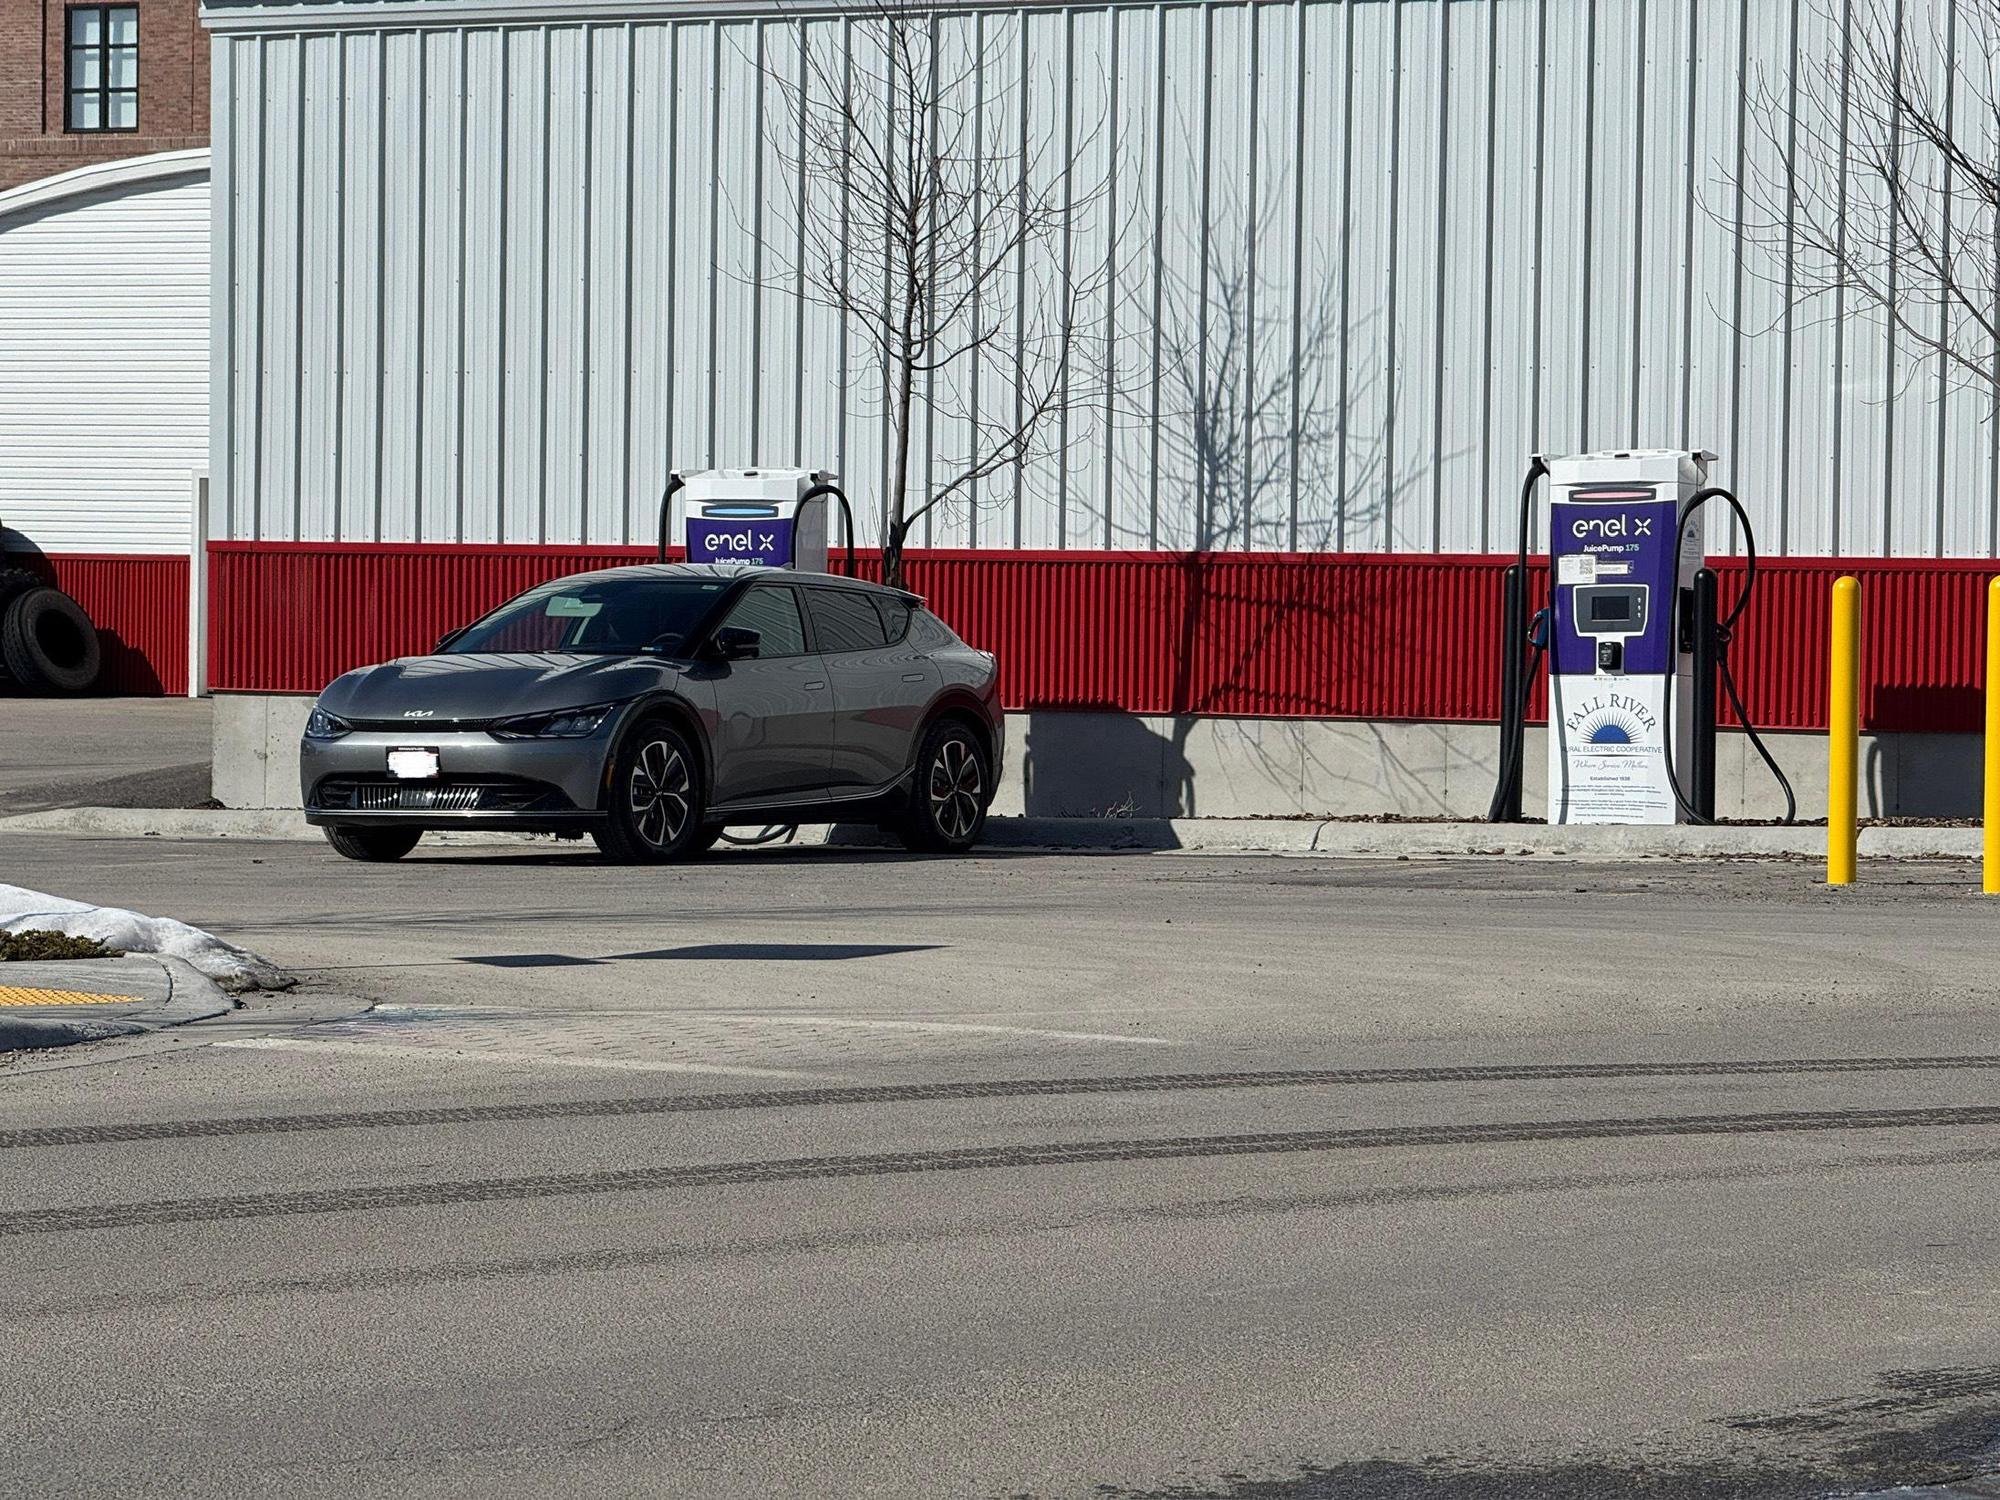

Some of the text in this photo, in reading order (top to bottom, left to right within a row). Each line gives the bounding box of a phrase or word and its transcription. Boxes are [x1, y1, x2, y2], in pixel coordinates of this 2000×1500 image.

[1572, 514, 1627, 537] enel
[705, 529, 753, 551] enel
[1583, 544, 1639, 553] JuicePump 175
[1566, 693, 1656, 733] FALL RIVER
[1583, 745, 1615, 753] ELECTRIC
